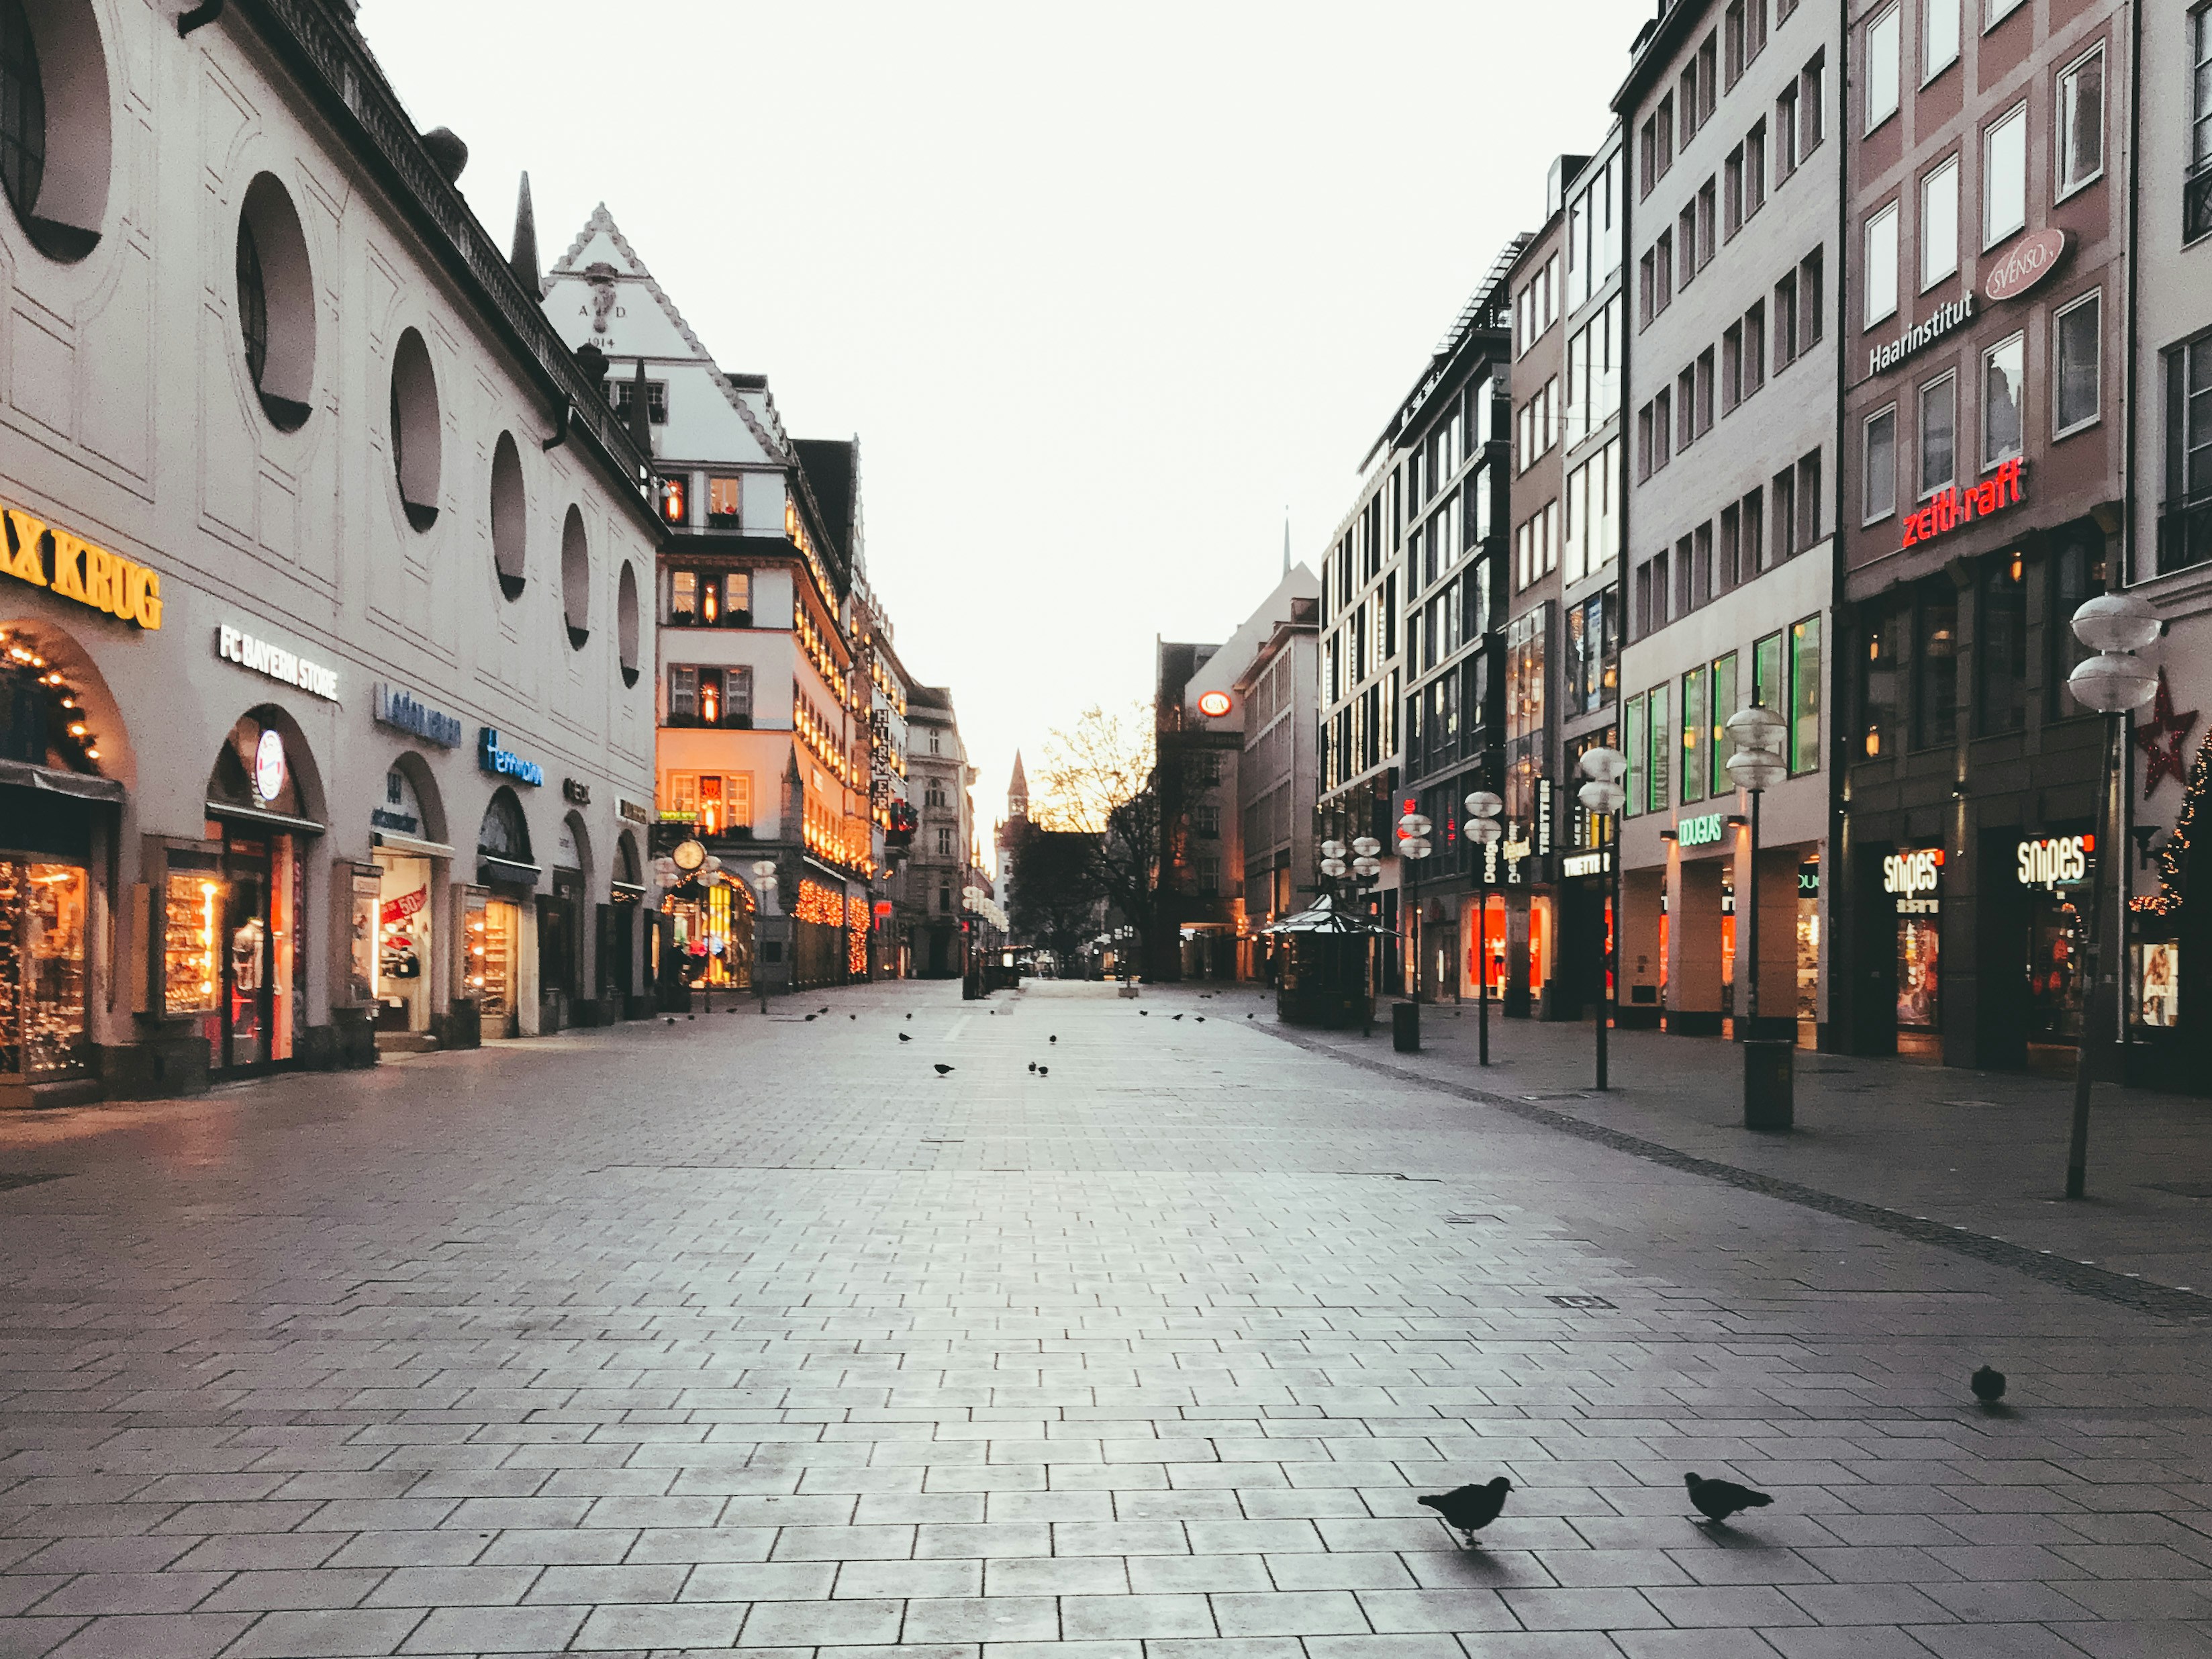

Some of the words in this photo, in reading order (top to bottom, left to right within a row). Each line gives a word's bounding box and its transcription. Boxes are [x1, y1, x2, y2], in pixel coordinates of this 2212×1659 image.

[1992, 244, 2054, 293] SVENSON
[1869, 289, 1972, 376] Haarinstitut
[1902, 456, 2023, 548] zeitkraft
[50, 528, 163, 630] KRUG
[220, 622, 242, 663] FC
[242, 633, 297, 685] BAYERN
[299, 657, 338, 701] STORE
[877, 710, 888, 810] HIRMER
[1539, 779, 1550, 855] TRETTER
[1678, 813, 1723, 847] DOUGLAS
[1884, 852, 1937, 900] snipes
[2018, 835, 2085, 891] snipes
